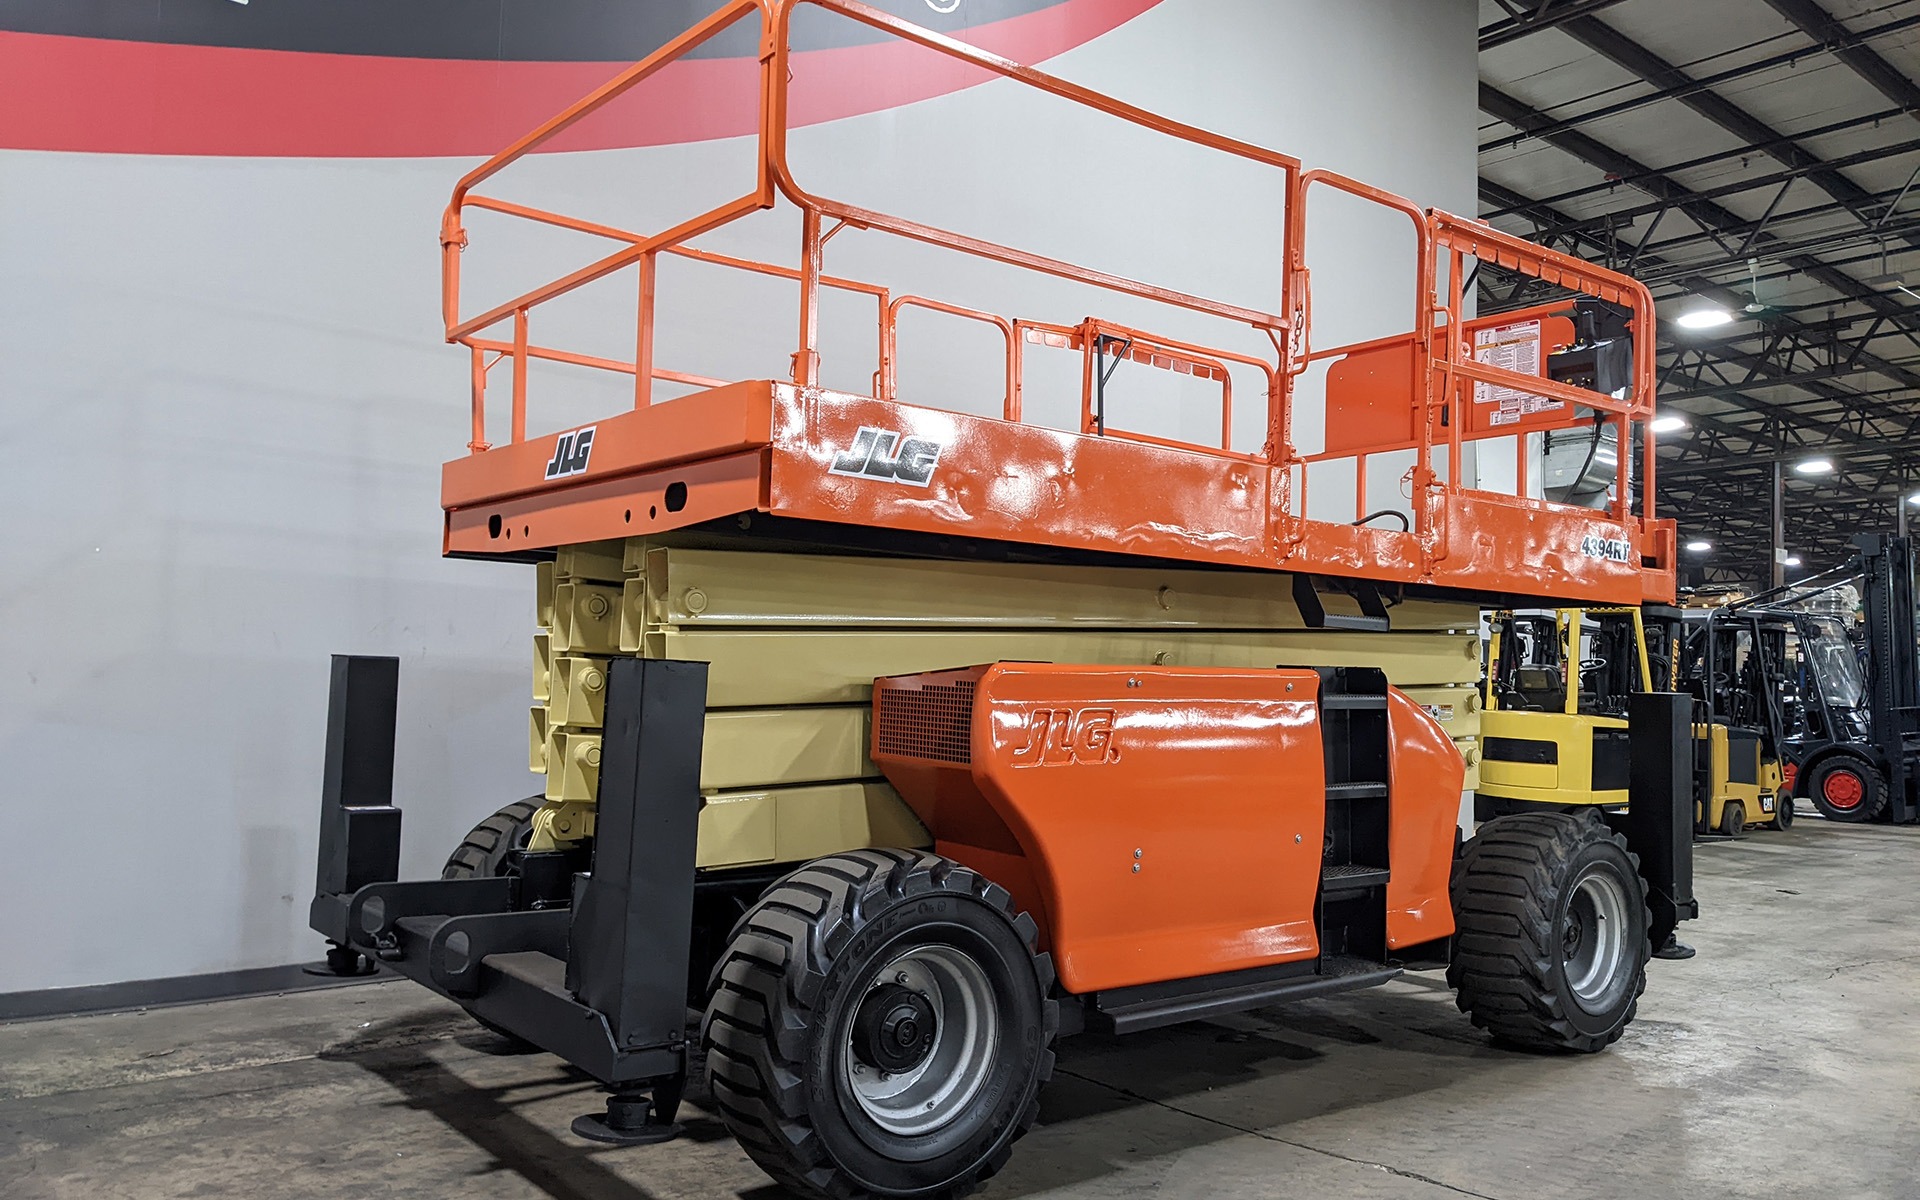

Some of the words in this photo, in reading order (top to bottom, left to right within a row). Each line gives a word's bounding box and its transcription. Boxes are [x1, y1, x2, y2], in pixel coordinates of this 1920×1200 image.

[544, 425, 597, 481] JLG
[828, 426, 943, 488] JLG
[1581, 535, 1630, 563] 4394RT
[1670, 638, 1680, 692] HYSTER
[1763, 797, 1773, 812] CAT
